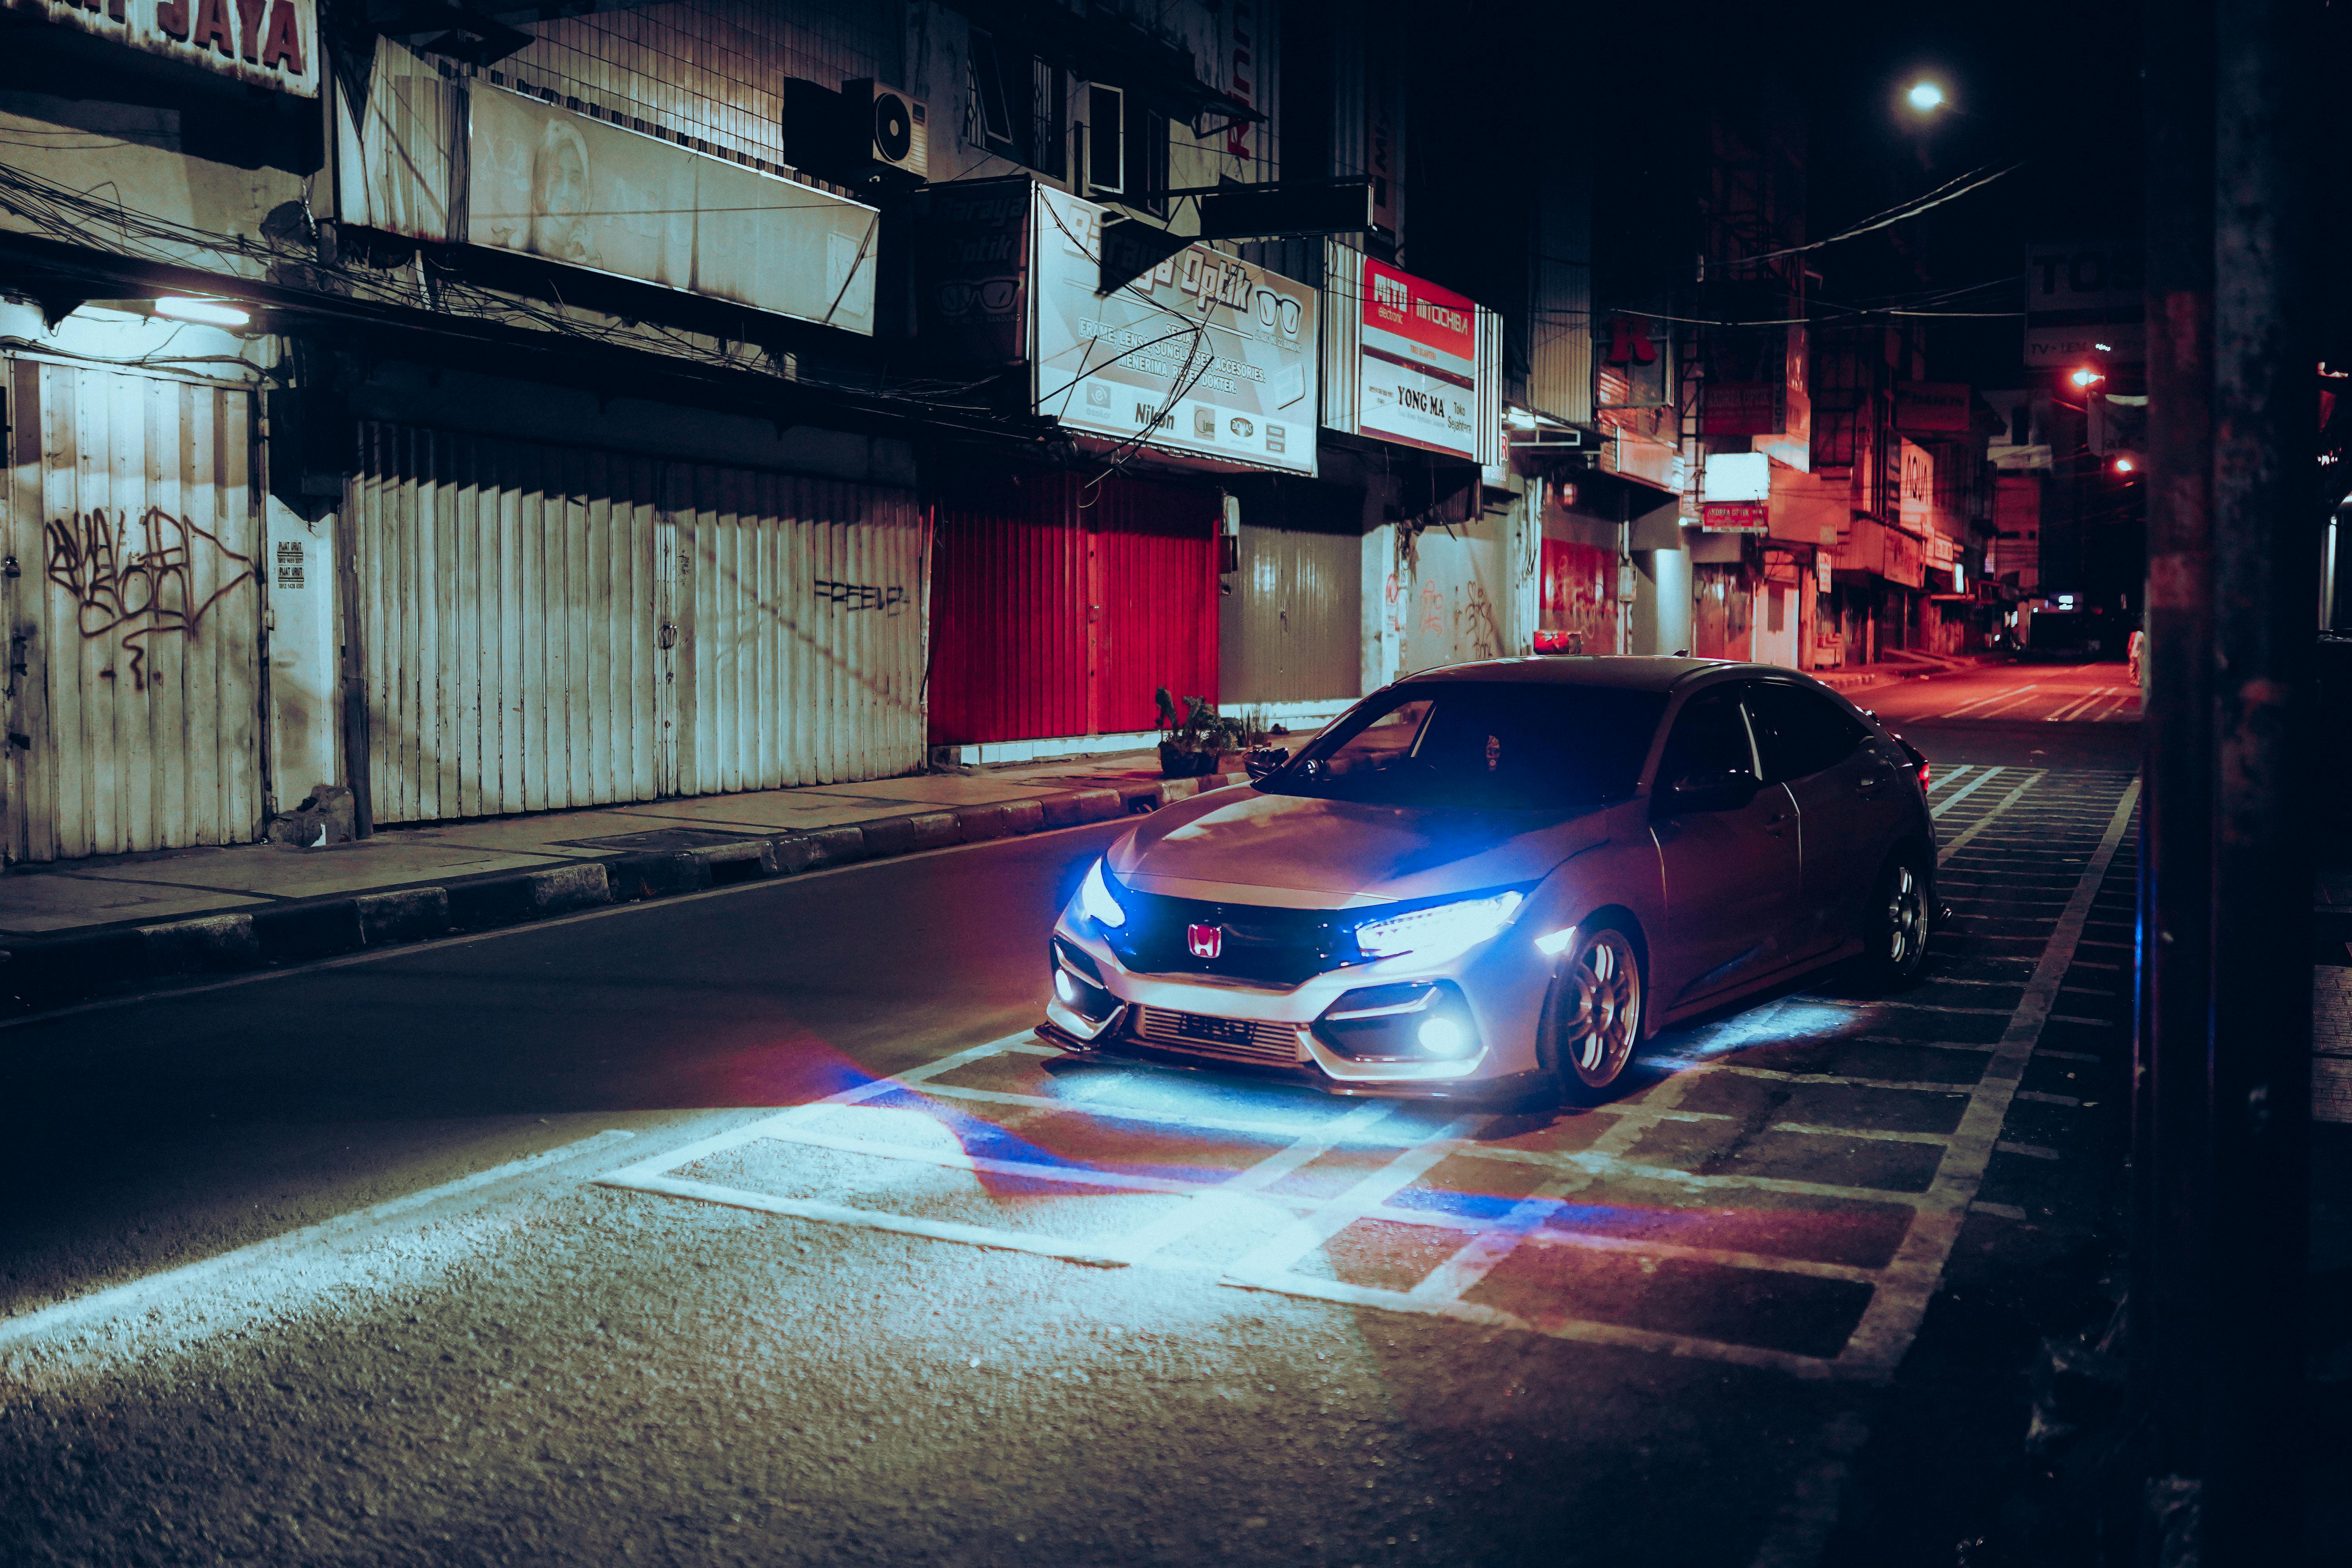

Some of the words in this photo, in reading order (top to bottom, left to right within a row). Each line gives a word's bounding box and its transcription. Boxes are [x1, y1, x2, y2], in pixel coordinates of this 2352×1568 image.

[158, 0, 302, 75] JAYA
[1181, 249, 1252, 313] Optik
[1166, 323, 1192, 345] SEDIA
[1119, 351, 1168, 377] MENERIMA
[1086, 408, 1111, 419] essilor
[1398, 386, 1427, 412] YONG
[1430, 395, 1445, 418] MA
[1454, 401, 1466, 417] Toko
[1136, 403, 1175, 430] Nikon
[1448, 416, 1472, 434] Sejahtera
[1905, 454, 1928, 505] AQUA
